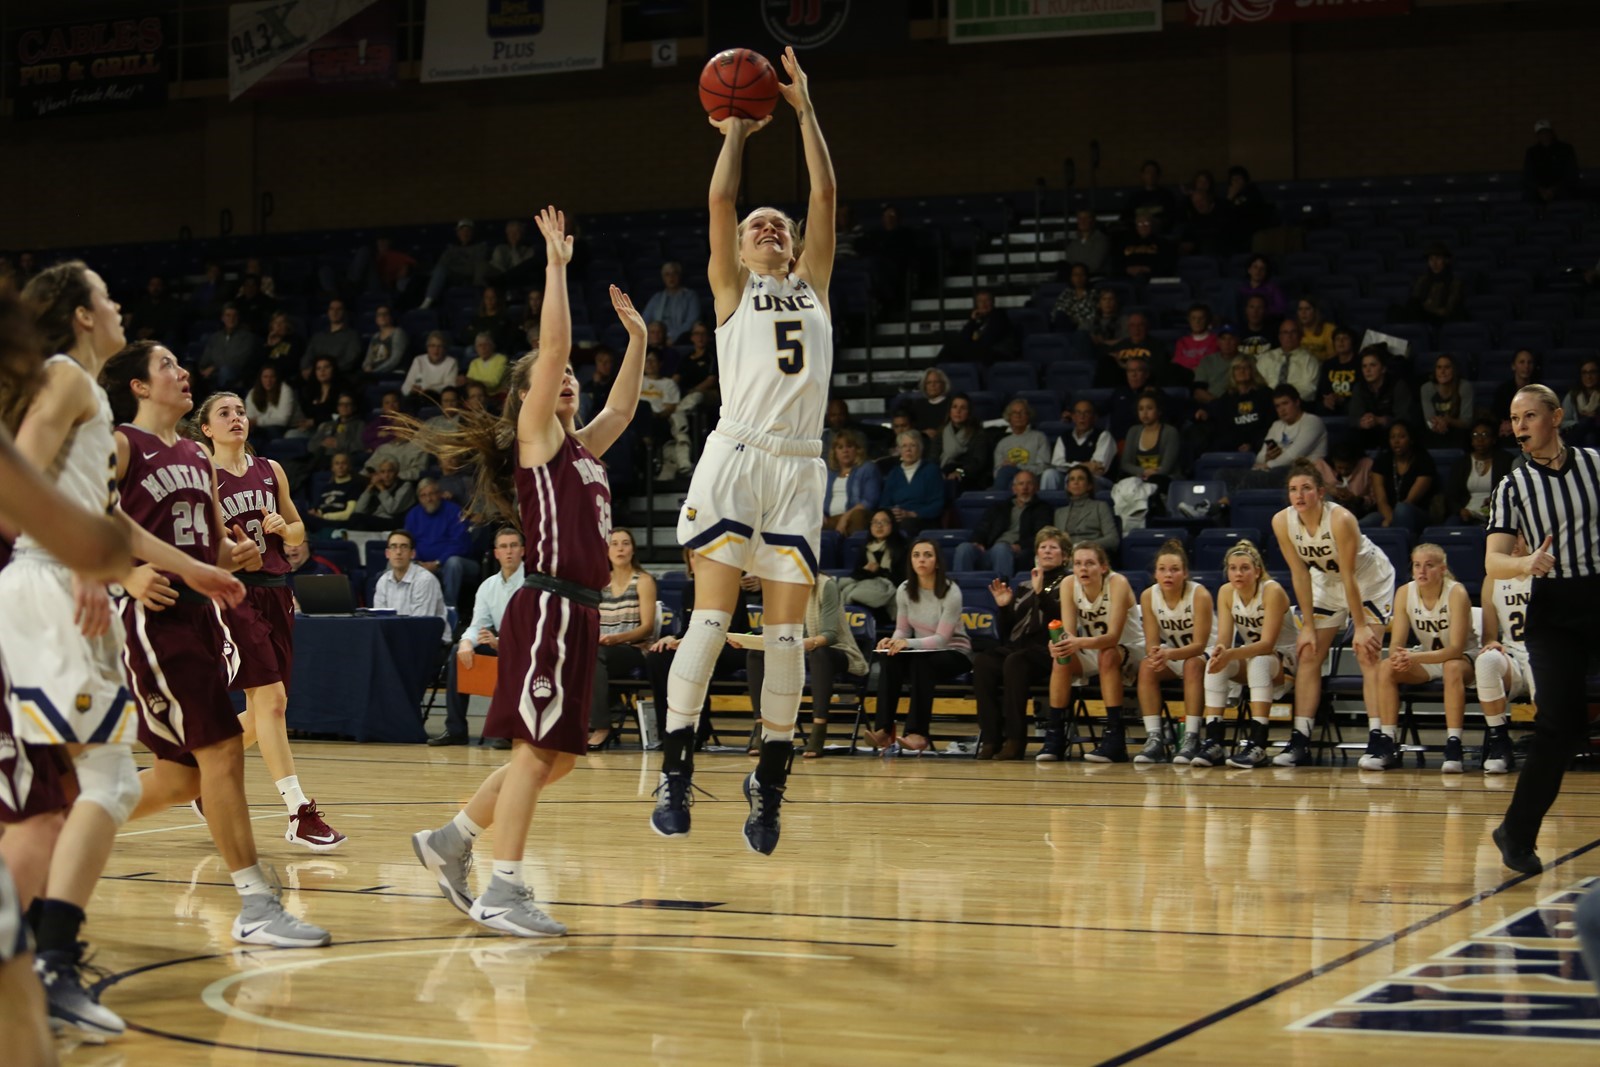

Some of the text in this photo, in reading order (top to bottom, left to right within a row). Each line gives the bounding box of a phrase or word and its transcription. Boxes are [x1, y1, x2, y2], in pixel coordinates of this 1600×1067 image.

[17, 17, 163, 64] CABLES
[658, 44, 671, 61] C
[20, 53, 160, 86] PUB & GRILL
[752, 294, 814, 312] UNC
[774, 320, 804, 375] 5
[1332, 381, 1350, 393] GO
[1234, 412, 1259, 425] UNC
[140, 464, 213, 503] MONTAN
[171, 501, 210, 547] 24
[245, 519, 266, 554] 3
[1297, 545, 1333, 557] UNC
[1505, 592, 1531, 606] UN
[960, 613, 993, 630] NC
[1078, 606, 1107, 621] UNC
[1235, 614, 1264, 628] UNC
[1160, 619, 1194, 631] UNC
[1415, 619, 1449, 632] UNC
